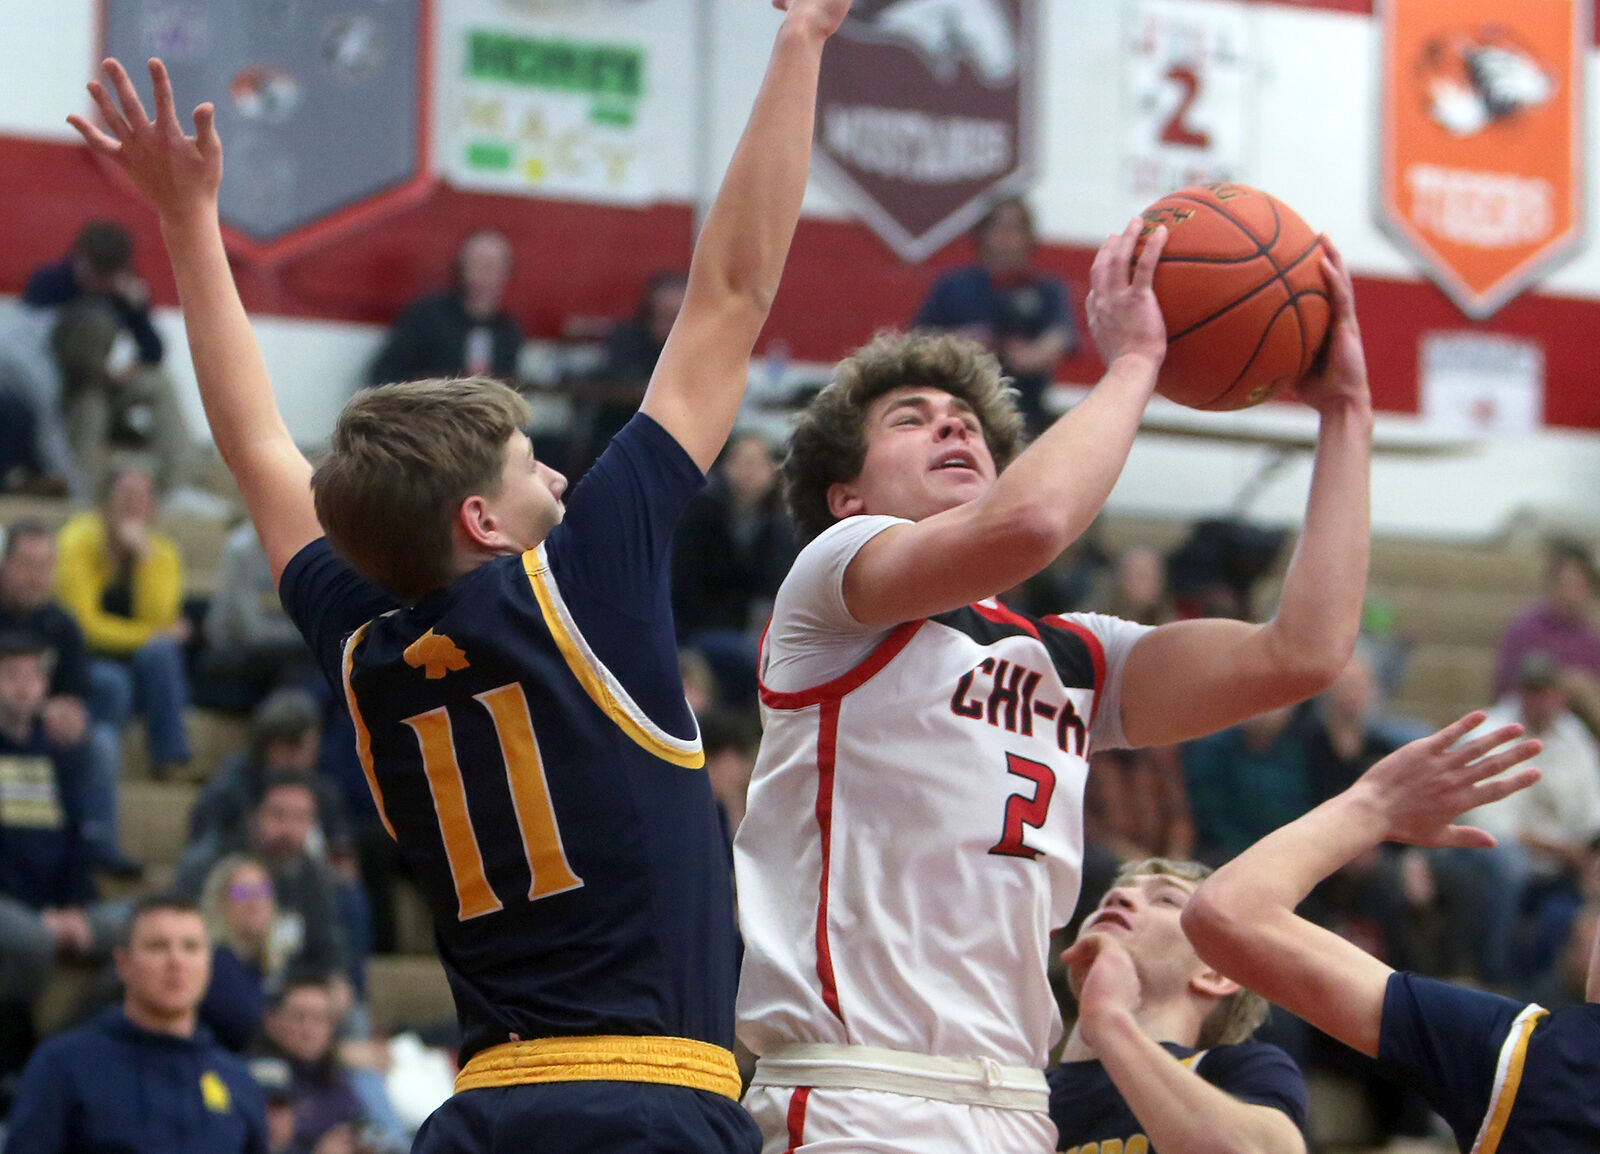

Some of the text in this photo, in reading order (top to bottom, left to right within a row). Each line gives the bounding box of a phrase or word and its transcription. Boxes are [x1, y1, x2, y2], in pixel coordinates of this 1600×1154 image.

[1158, 61, 1211, 149] 2
[399, 681, 585, 922] 11
[987, 750, 1056, 861] 2
